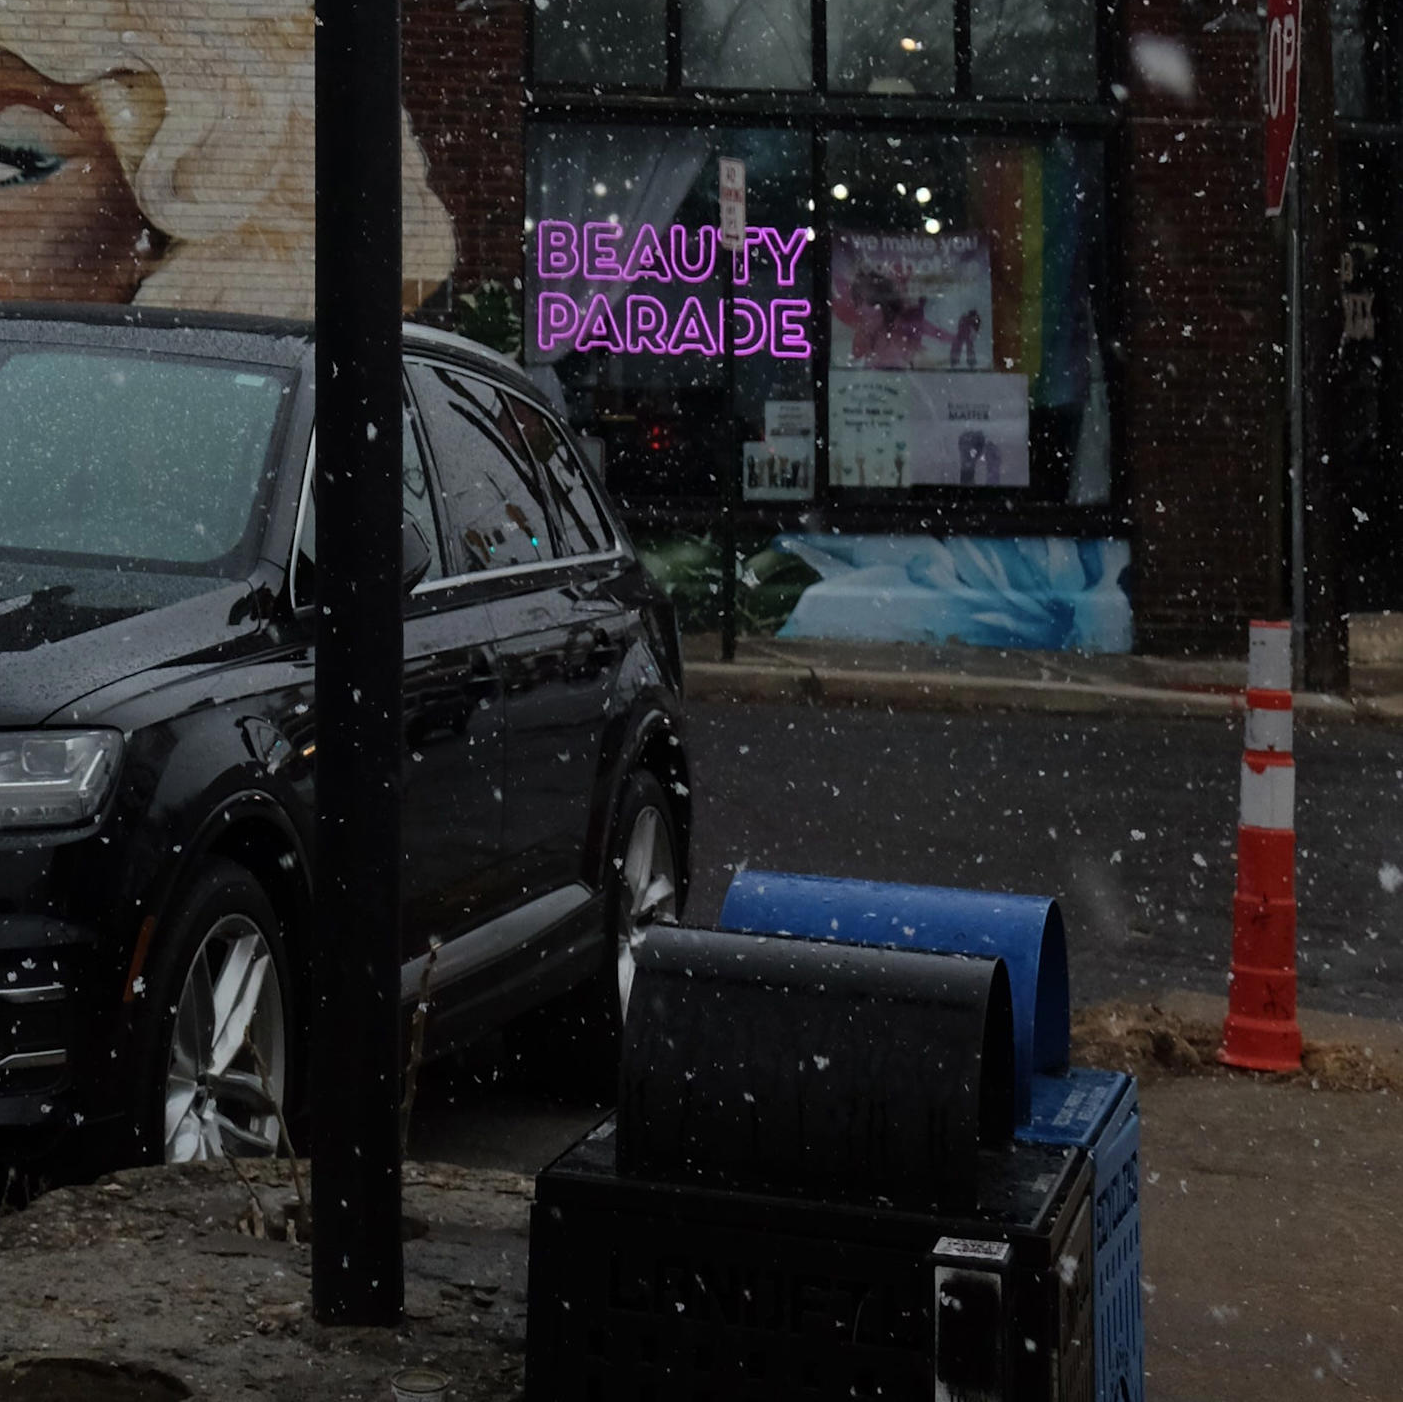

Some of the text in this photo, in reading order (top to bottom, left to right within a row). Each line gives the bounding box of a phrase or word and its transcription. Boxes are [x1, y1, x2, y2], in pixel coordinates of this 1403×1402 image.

[1269, 14, 1296, 120] OP
[537, 221, 808, 286] BEAUTY
[882, 235, 937, 253] make
[940, 235, 978, 257] you
[538, 292, 811, 358] PARADE
